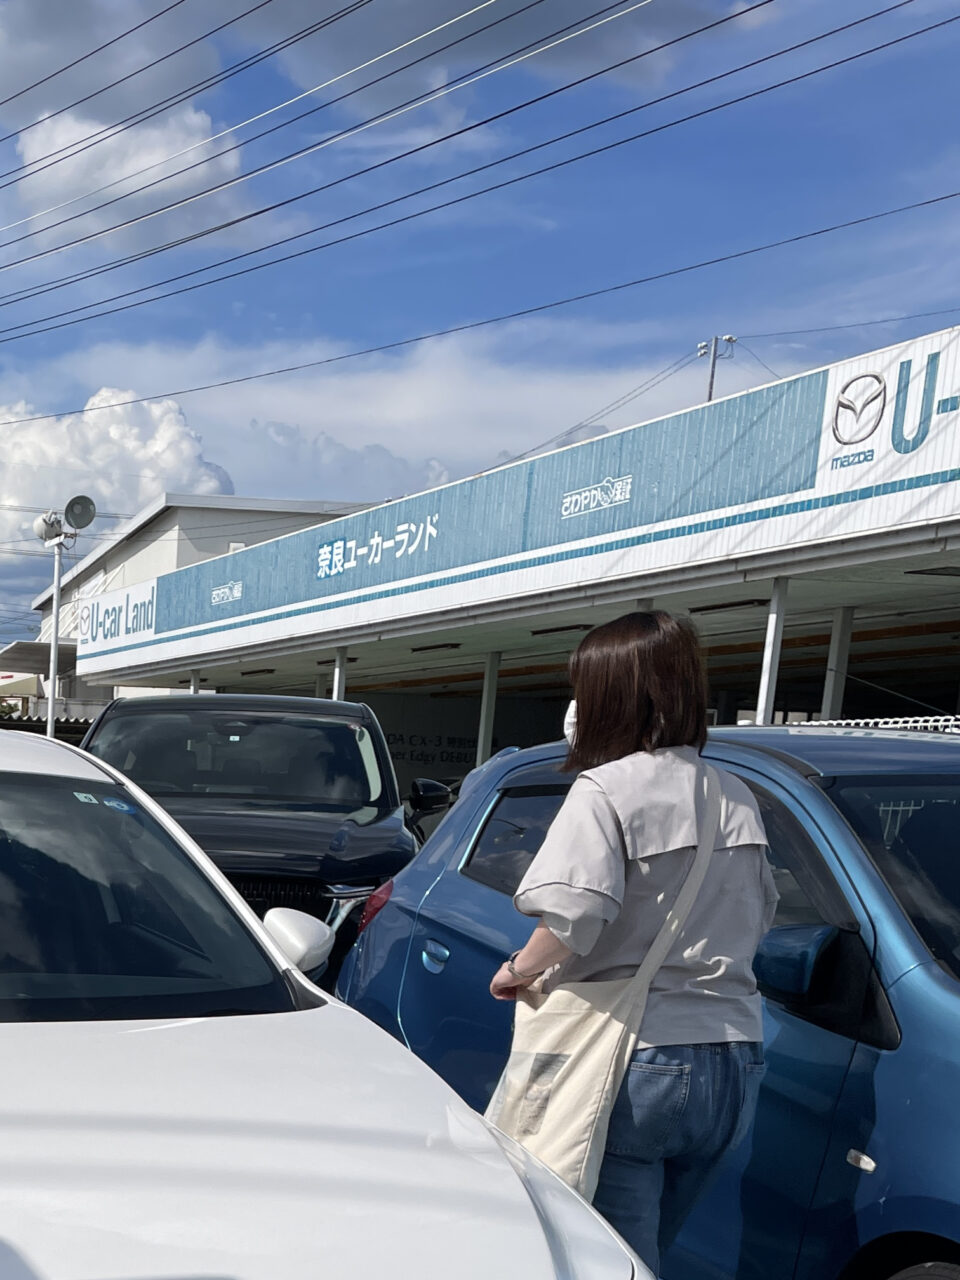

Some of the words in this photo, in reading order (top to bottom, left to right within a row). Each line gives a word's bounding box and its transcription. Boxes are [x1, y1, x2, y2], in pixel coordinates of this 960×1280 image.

[317, 514, 439, 578] 奈良ユーカーランド
[90, 602, 123, 642] U-car
[125, 587, 155, 635] Land
